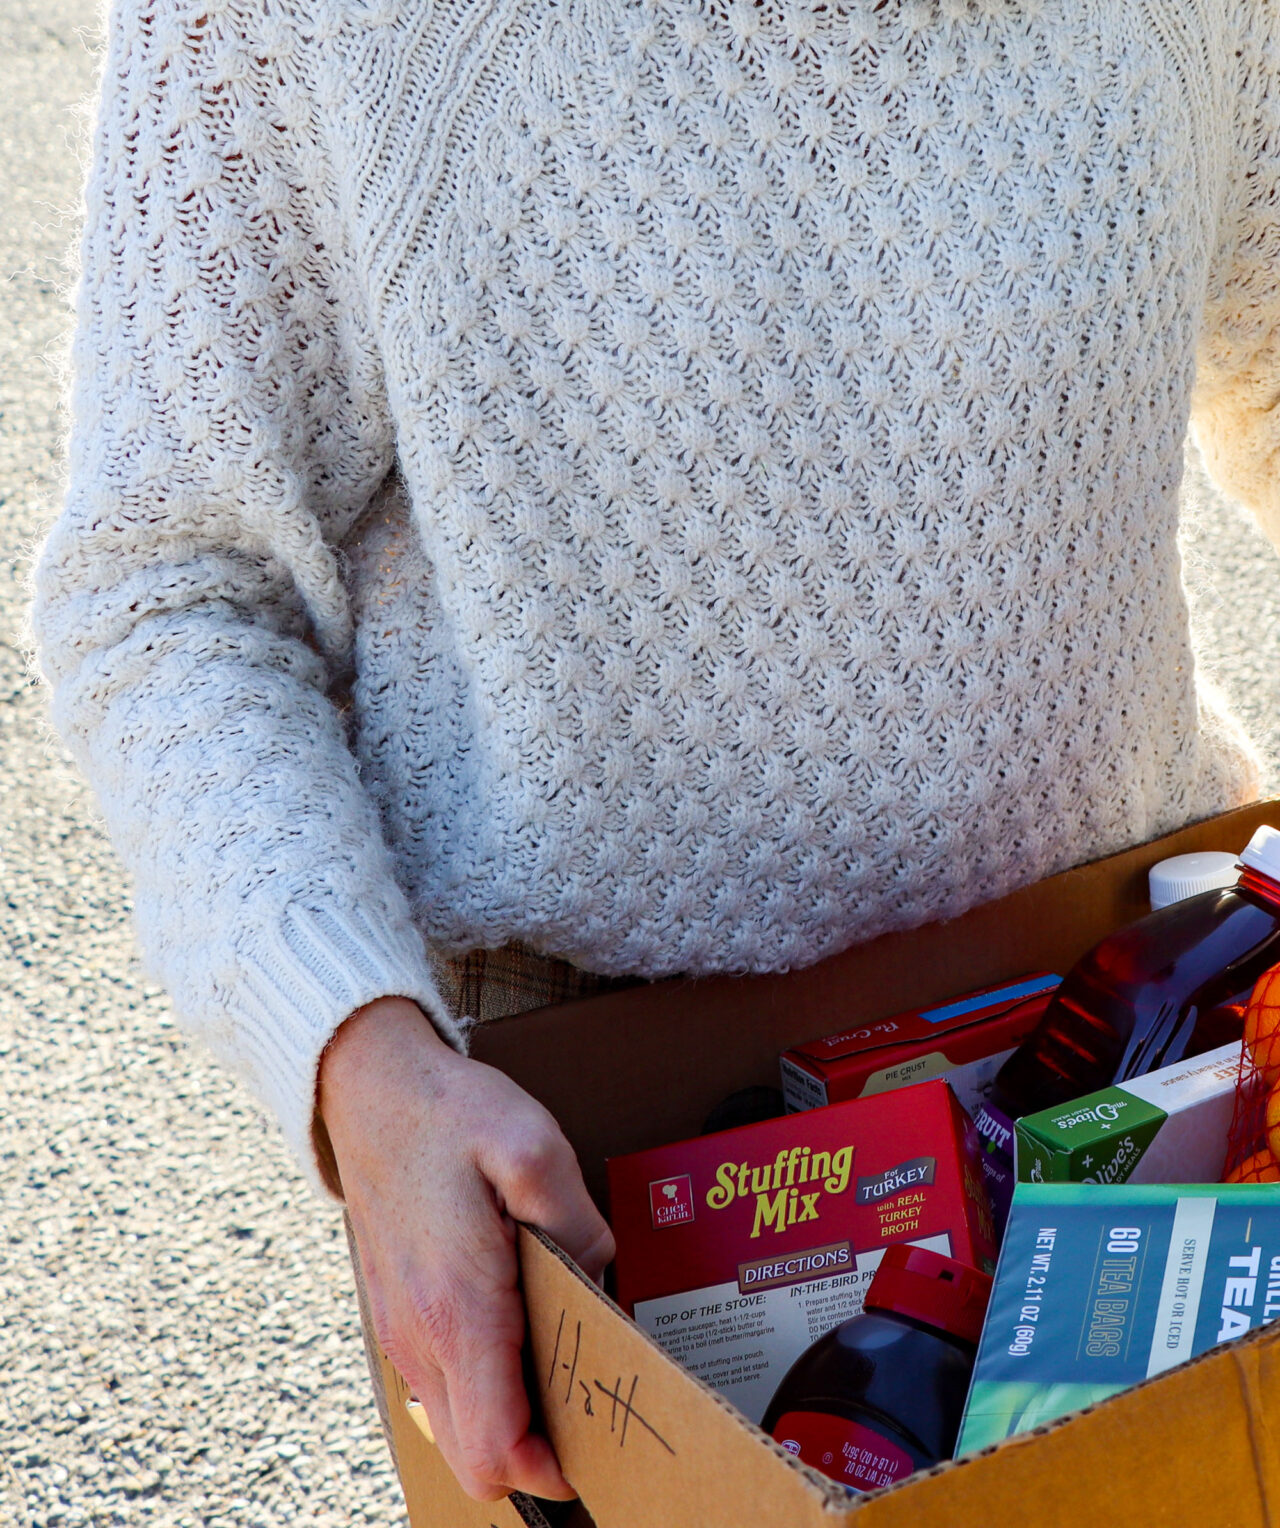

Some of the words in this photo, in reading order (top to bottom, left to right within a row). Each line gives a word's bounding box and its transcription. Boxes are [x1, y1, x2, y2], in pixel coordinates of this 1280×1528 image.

[886, 1069, 899, 1082] PIE
[900, 1061, 927, 1077] CRUST
[1057, 1103, 1119, 1129] Olive's
[706, 1146, 854, 1210] Stuffing
[863, 1166, 928, 1200] TURKEY
[884, 1169, 898, 1180] For
[750, 1188, 821, 1239] Mix
[877, 1202, 895, 1213] with
[897, 1192, 927, 1208] REAL
[879, 1206, 922, 1224] TURKEY
[881, 1220, 919, 1237] BROTH
[1036, 1228, 1057, 1251] NET
[1106, 1227, 1142, 1253] 60
[744, 1248, 849, 1284] DIRECTIONS
[1179, 1238, 1197, 1275] SERVE
[790, 1275, 859, 1298] IN-THE-BIRD
[1098, 1256, 1137, 1295] TEA
[1174, 1277, 1191, 1300] HOT
[1216, 1246, 1262, 1343] TEA
[655, 1314, 678, 1327] TOP
[680, 1308, 698, 1321] OF
[700, 1303, 723, 1317] THE
[725, 1295, 767, 1311] STOVE:
[1019, 1305, 1040, 1323] OZ
[1172, 1302, 1187, 1320] OR
[663, 1328, 688, 1338] medium
[719, 1317, 732, 1326] heat
[1086, 1300, 1130, 1357] BAGS
[1166, 1321, 1183, 1349] ICED
[1008, 1325, 1035, 1357] (60g)
[844, 1461, 857, 1474] OZ
[856, 1464, 867, 1478] 20
[864, 1469, 878, 1484] WT
